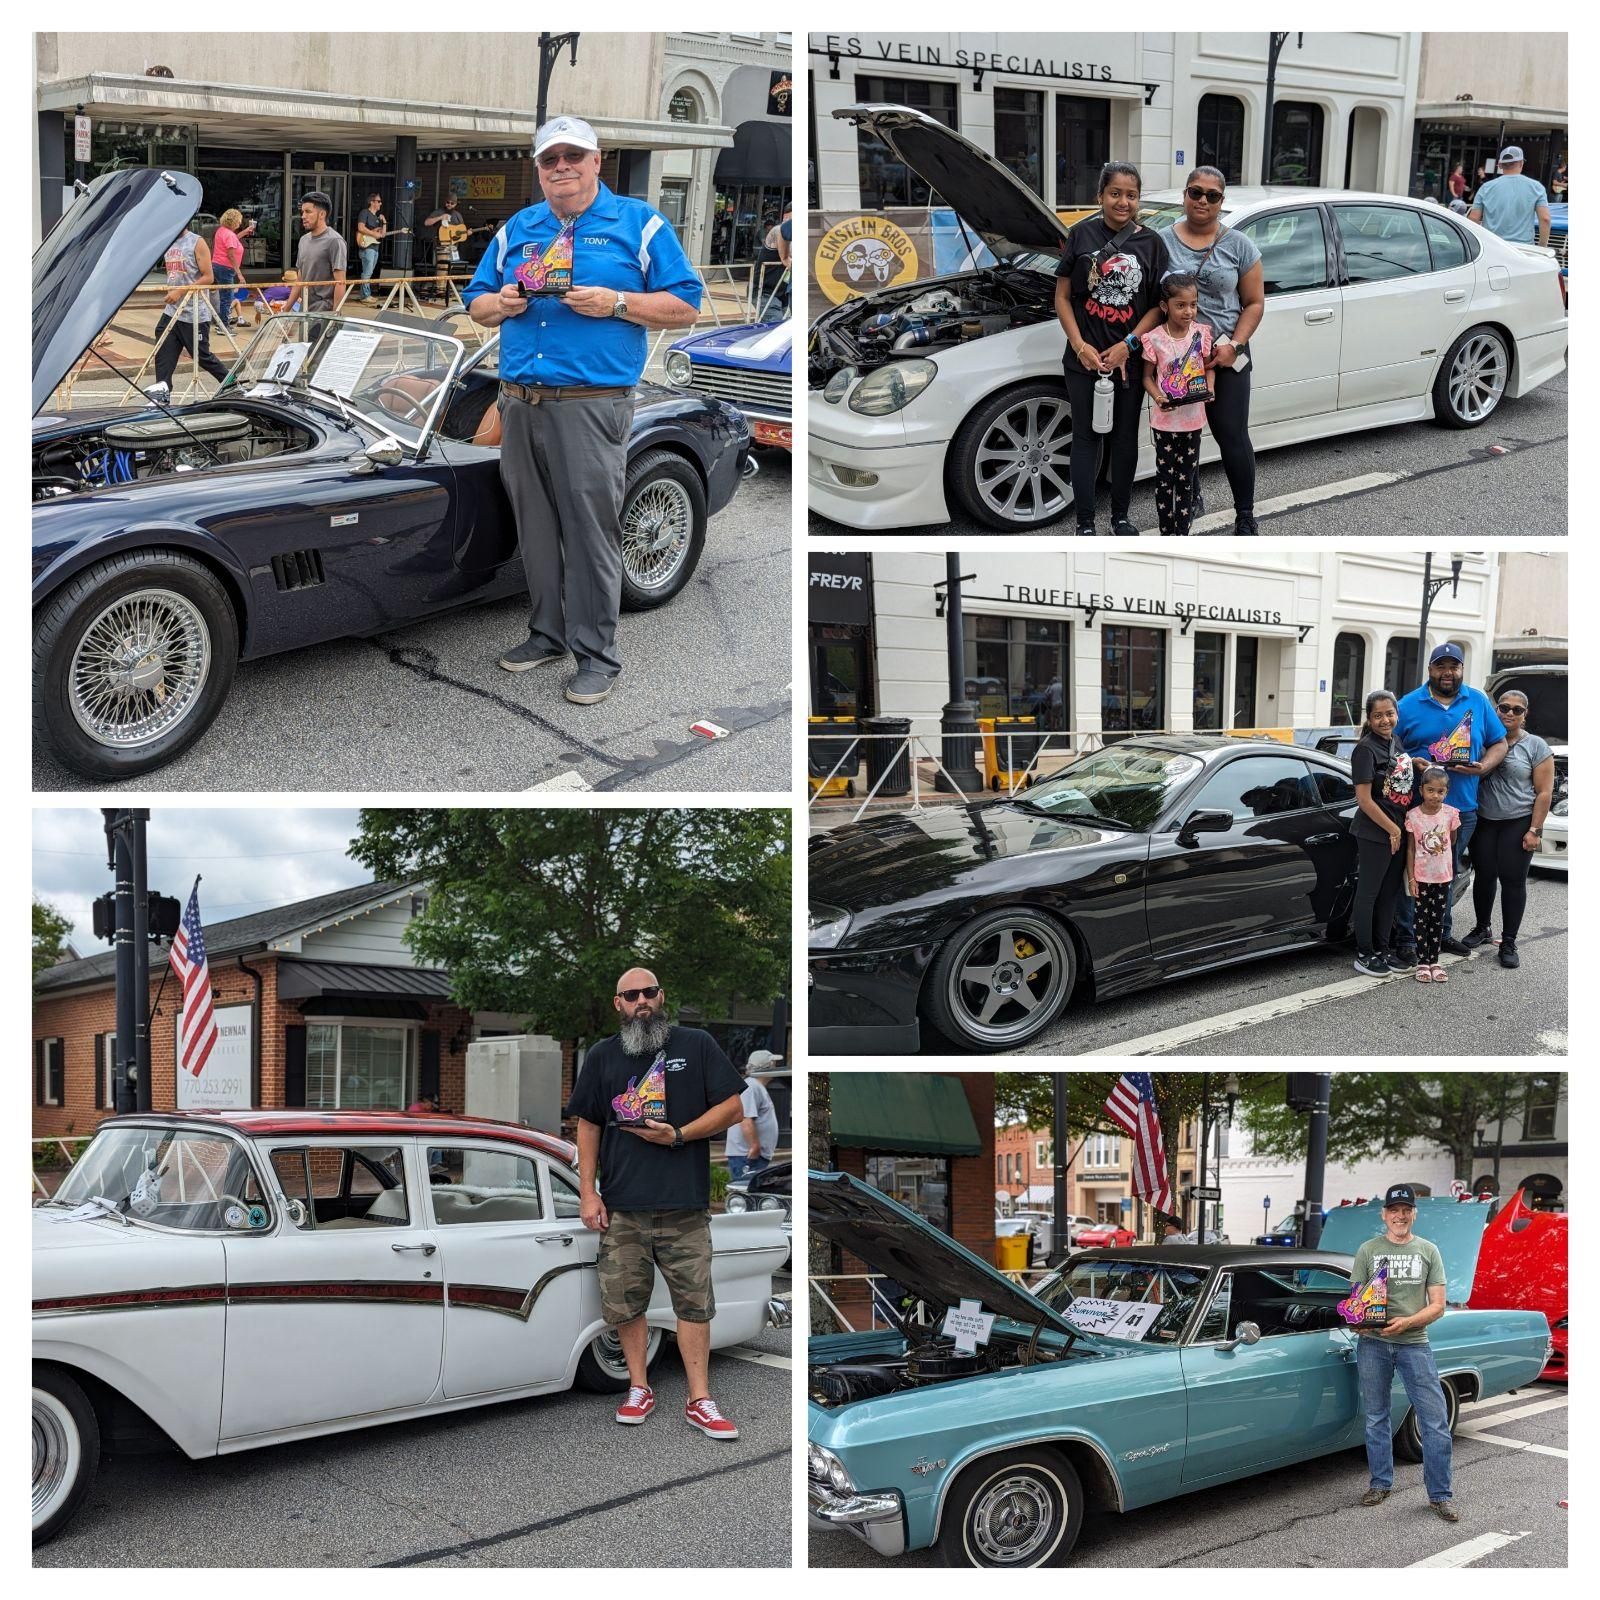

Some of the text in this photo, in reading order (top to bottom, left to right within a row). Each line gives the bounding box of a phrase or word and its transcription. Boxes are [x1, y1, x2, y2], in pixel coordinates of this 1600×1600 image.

[877, 40, 940, 64] VEIN
[955, 49, 1112, 81] SPECIALISTS
[80, 120, 87, 129] NO
[471, 176, 499, 188] SPRING
[584, 238, 610, 246] TONY
[820, 220, 912, 261] EINSTEIN BROS
[1085, 298, 1134, 323] JAPAN
[273, 360, 291, 379] 10
[809, 572, 863, 591] FREYR
[1003, 584, 1281, 625] TRUFFLES VEIN SPECIALISTS
[220, 1024, 247, 1037] NEWNAN
[184, 1079, 243, 1095] 770.253.2991
[1373, 1260, 1411, 1269] DINK
[1072, 1307, 1108, 1318] SURVIVOR
[1125, 1314, 1144, 1327] 41
